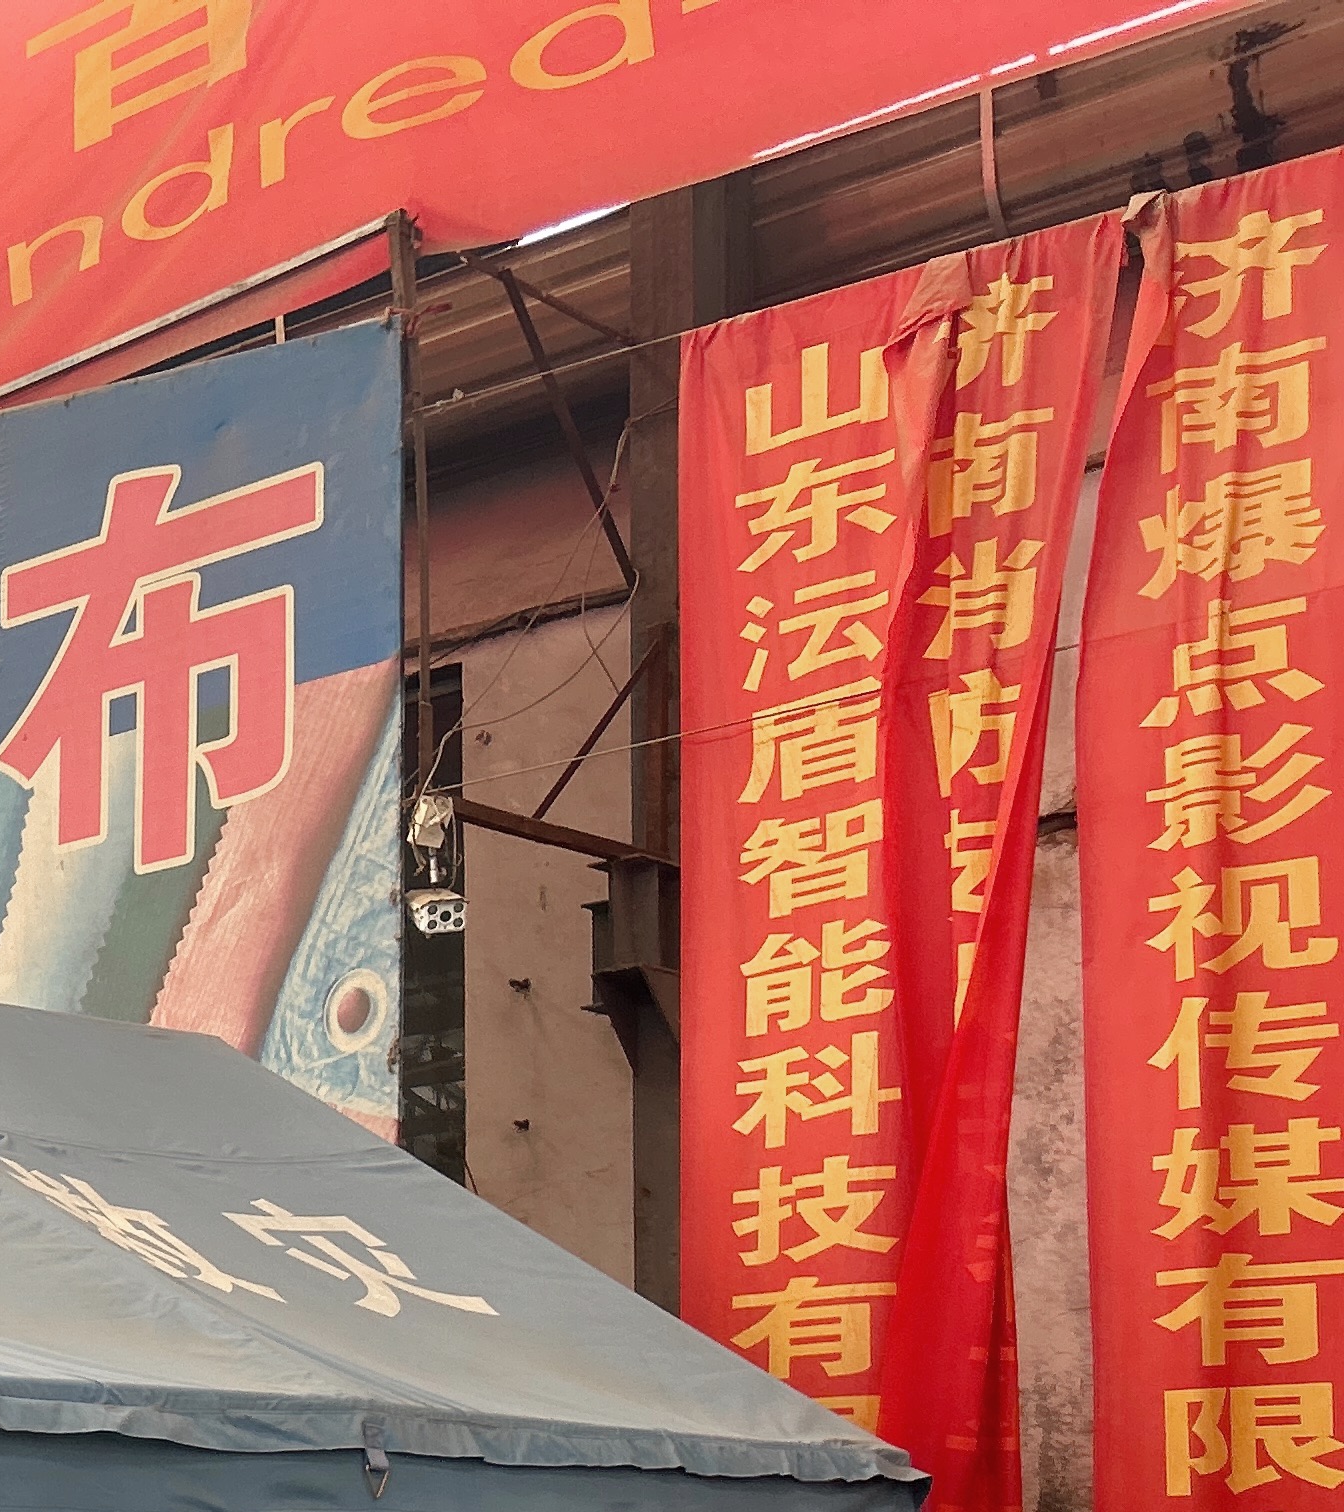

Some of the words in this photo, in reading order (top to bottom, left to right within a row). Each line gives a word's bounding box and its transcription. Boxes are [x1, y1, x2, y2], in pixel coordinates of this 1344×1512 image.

[732, 343, 902, 1436] 山东沄盾智能科技有
